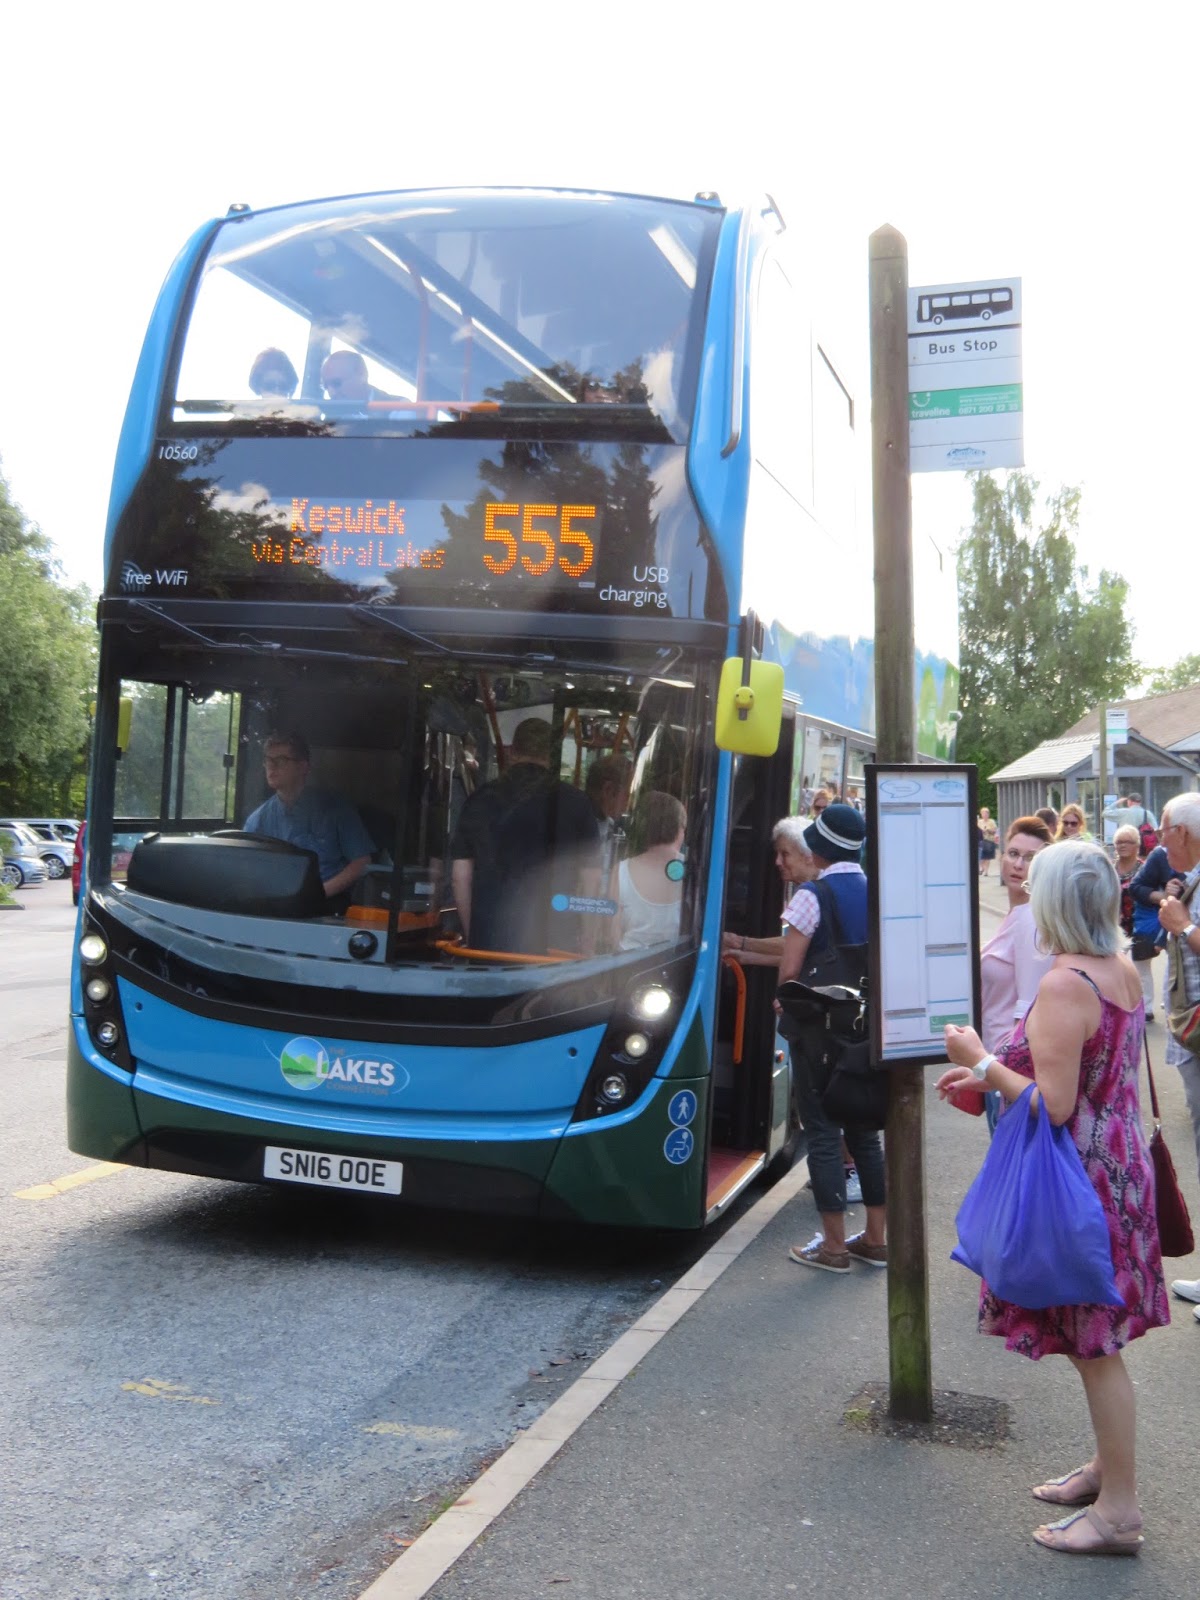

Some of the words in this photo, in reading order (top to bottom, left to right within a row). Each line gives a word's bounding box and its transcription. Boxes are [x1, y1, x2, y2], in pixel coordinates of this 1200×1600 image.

[929, 343, 955, 355] Bus
[963, 340, 998, 352] Stop
[911, 407, 950, 418] traveline
[158, 446, 198, 460] 10560
[290, 497, 406, 535] Keswick
[483, 503, 596, 577] 555
[252, 537, 284, 565] via
[289, 537, 375, 567] Central
[378, 541, 446, 569] Lakes
[126, 569, 152, 586] free
[155, 569, 188, 586] WiFi
[633, 565, 669, 583] USB
[599, 585, 668, 608] charging
[569, 896, 608, 906] EMERGENCY
[596, 906, 615, 915] OPEN
[316, 1051, 395, 1086] LAKES
[280, 1152, 331, 1180] SN16
